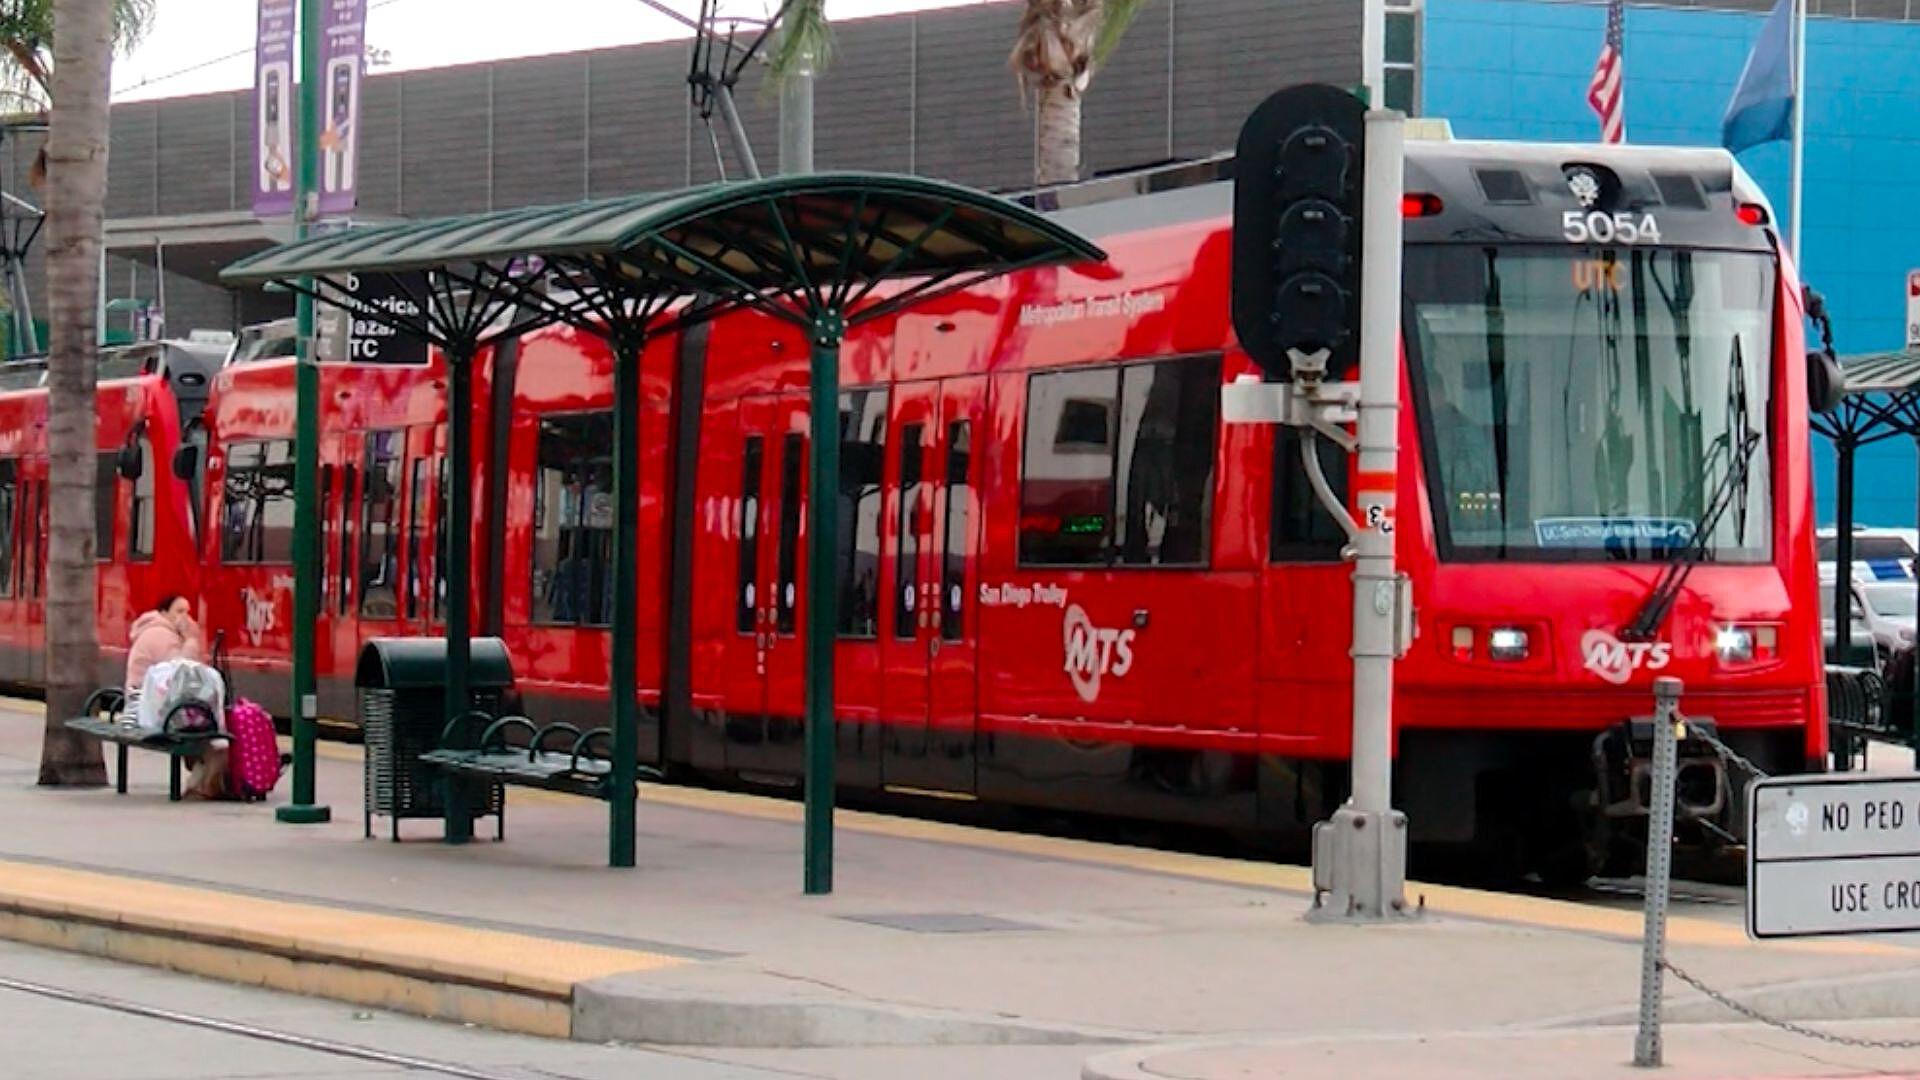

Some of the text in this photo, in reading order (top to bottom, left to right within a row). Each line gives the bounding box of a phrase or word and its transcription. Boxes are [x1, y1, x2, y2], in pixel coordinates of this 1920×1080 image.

[1563, 211, 1660, 244] 5054
[1571, 259, 1626, 290] UTC
[348, 295, 420, 315] merica
[1020, 291, 1166, 328] Metropolitan Transit System
[349, 339, 379, 358] TC
[980, 582, 1067, 608] San Diego Trolley
[1064, 625, 1136, 678] MTS
[1583, 642, 1672, 670] MTS
[1822, 800, 1904, 831] NO PED
[1831, 882, 1870, 912] USE
